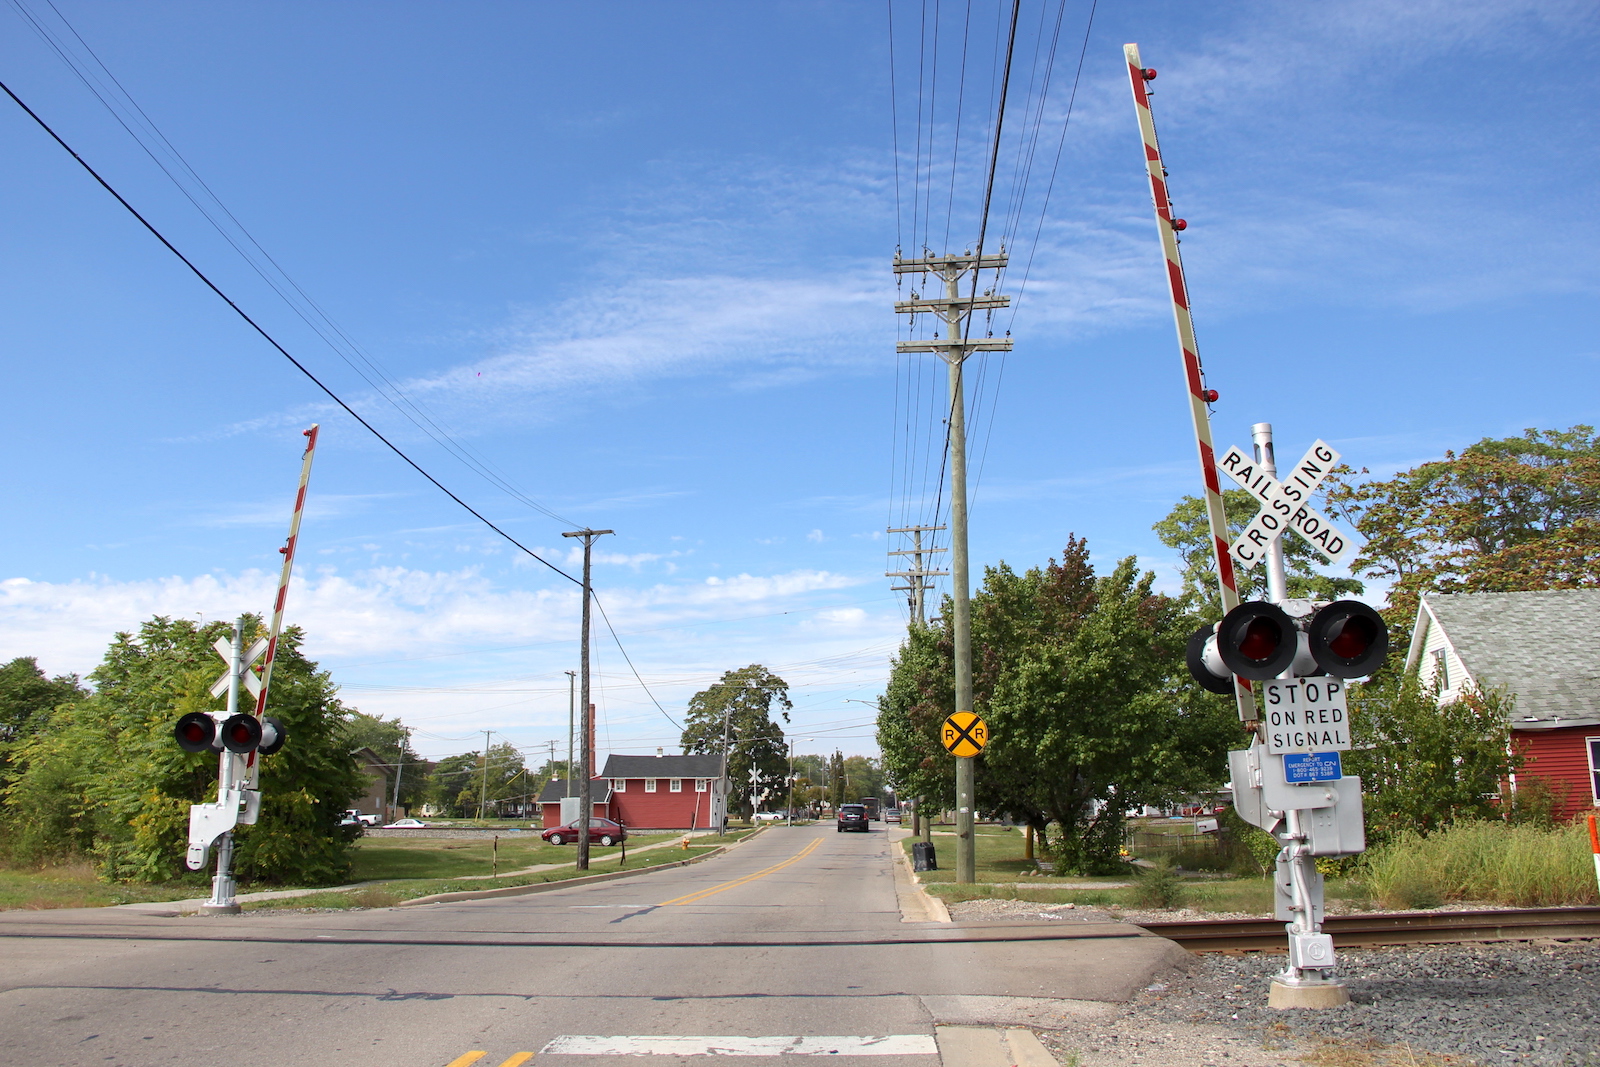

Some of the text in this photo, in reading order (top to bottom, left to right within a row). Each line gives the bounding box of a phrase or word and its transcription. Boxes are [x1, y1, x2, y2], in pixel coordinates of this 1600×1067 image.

[1222, 451, 1344, 555] RAIL ROAD
[1236, 446, 1333, 561] CROSSING
[1268, 683, 1340, 705] STOP
[1271, 708, 1342, 726] ON RED
[945, 728, 984, 740] R R
[1273, 730, 1346, 748] SIGNAL
